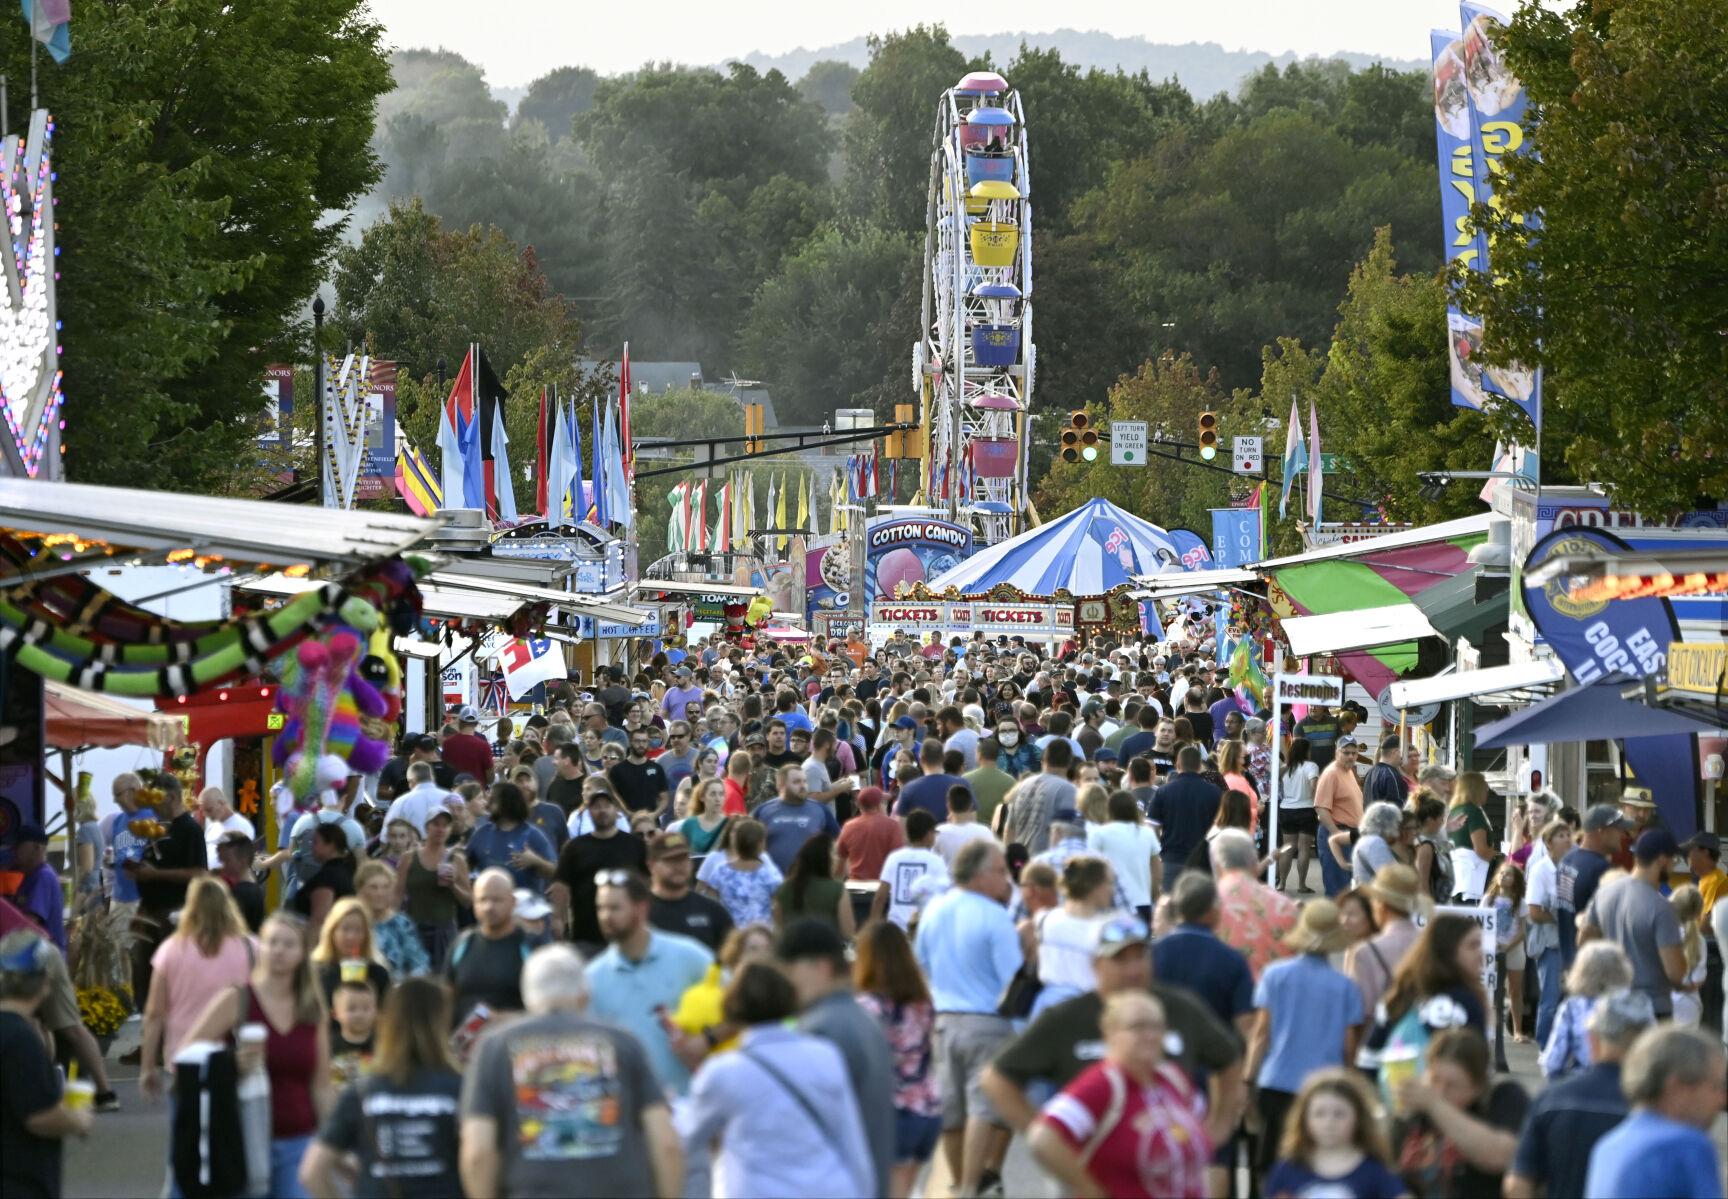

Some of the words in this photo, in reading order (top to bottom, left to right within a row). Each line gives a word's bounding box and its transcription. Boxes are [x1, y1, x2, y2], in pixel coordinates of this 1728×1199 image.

[367, 384, 394, 392] ONORS
[1119, 433, 1139, 441] YIELD
[1241, 438, 1255, 446] NO
[872, 524, 922, 546] COTTON
[925, 524, 966, 548] CANDY
[879, 608, 939, 621] TICKETS
[981, 609, 1044, 623] TICKETS
[602, 626, 619, 635] HOT
[622, 625, 656, 635] COFFEE
[1279, 680, 1341, 700] Restrooms
